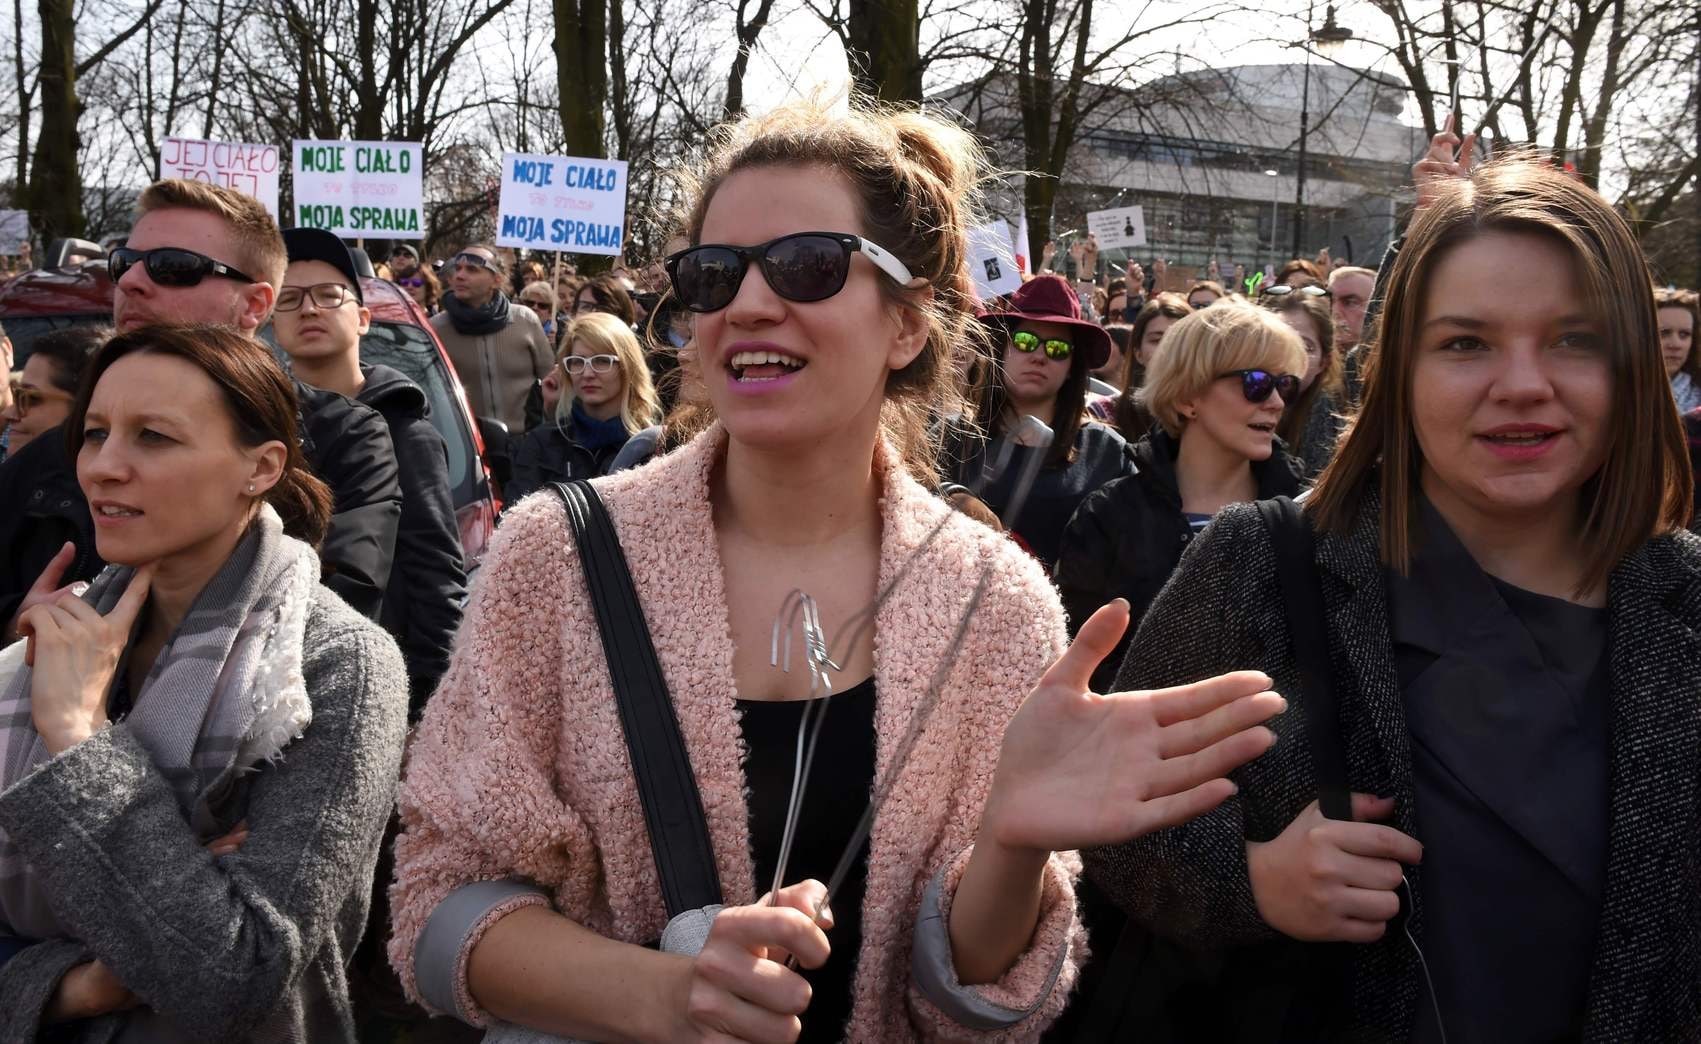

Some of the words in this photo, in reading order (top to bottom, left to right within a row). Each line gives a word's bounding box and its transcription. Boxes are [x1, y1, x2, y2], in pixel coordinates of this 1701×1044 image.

[164, 139, 208, 167] JEJ
[213, 143, 278, 173] CIAŁO
[301, 146, 345, 173] MOJE
[355, 147, 411, 173] CIAŁO
[513, 159, 554, 187] MOJE
[565, 165, 617, 191] CIAŁO
[299, 204, 345, 231] MOJA
[350, 206, 419, 231] SPRAWA
[502, 215, 545, 243] MOJA
[550, 218, 621, 248] SPRAWA
